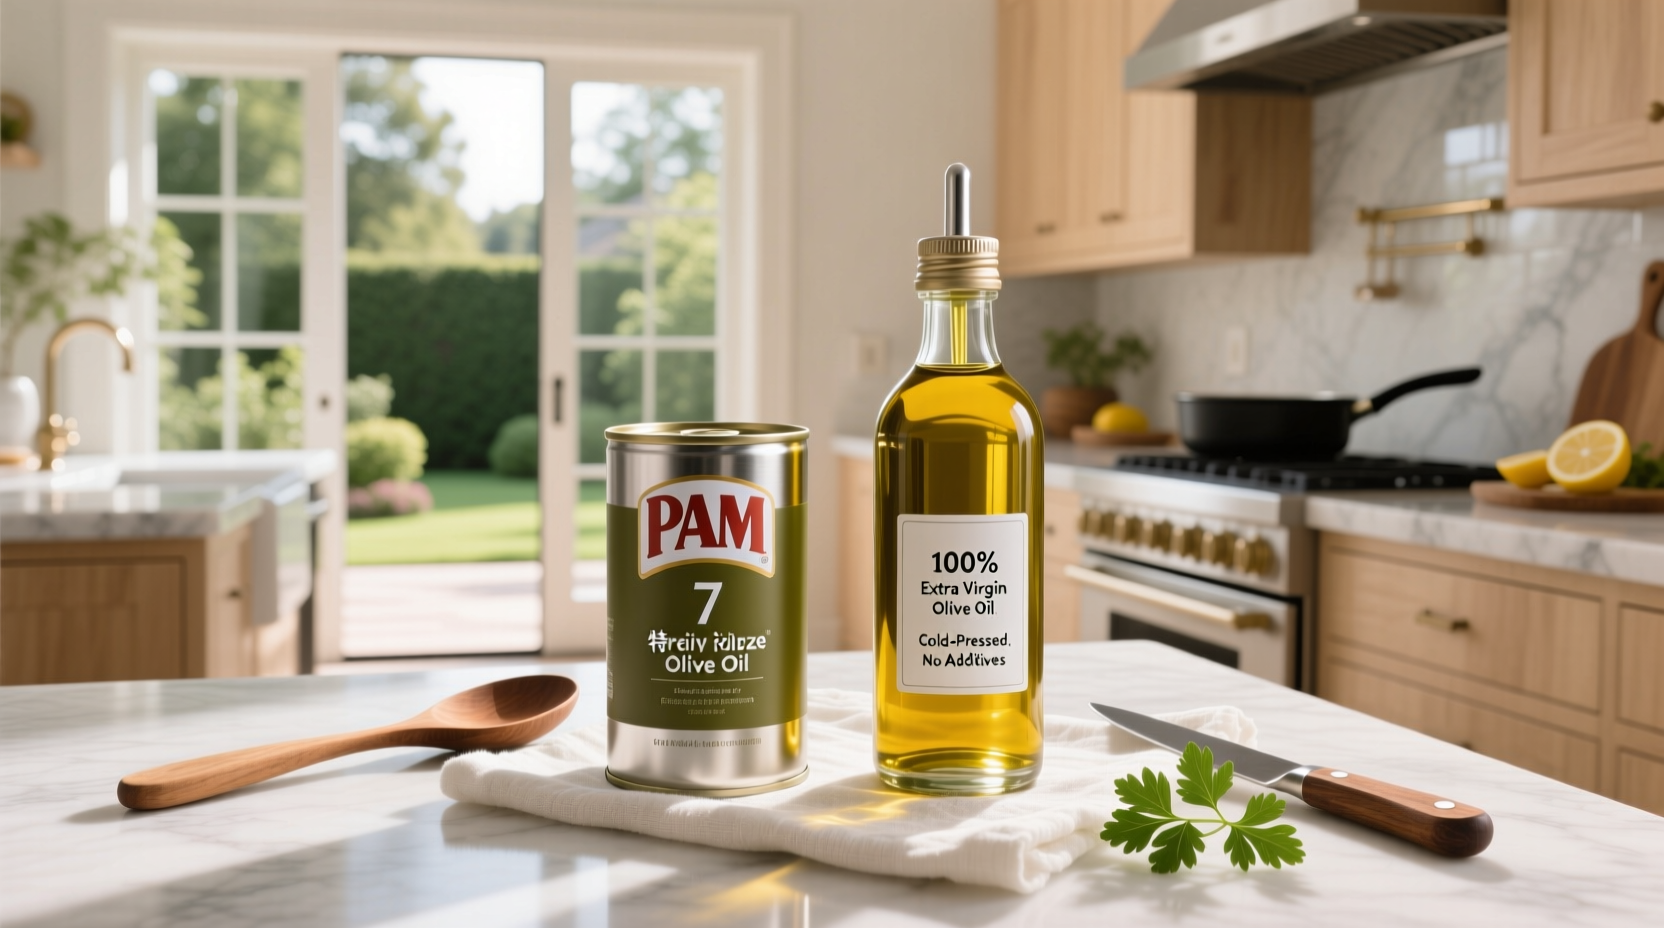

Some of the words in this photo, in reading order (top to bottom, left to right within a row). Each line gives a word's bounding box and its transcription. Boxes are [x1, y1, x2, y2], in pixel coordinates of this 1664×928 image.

[646, 494, 767, 559] PAM
[931, 550, 999, 574] 100%
[921, 580, 959, 596] Extra
[963, 580, 1008, 599] Virgin
[693, 581, 723, 625] 7
[932, 600, 971, 616] Olive
[664, 654, 716, 674] Olive
[721, 653, 749, 673] Oil
[922, 653, 942, 668] No
[944, 652, 1007, 668] Additives
